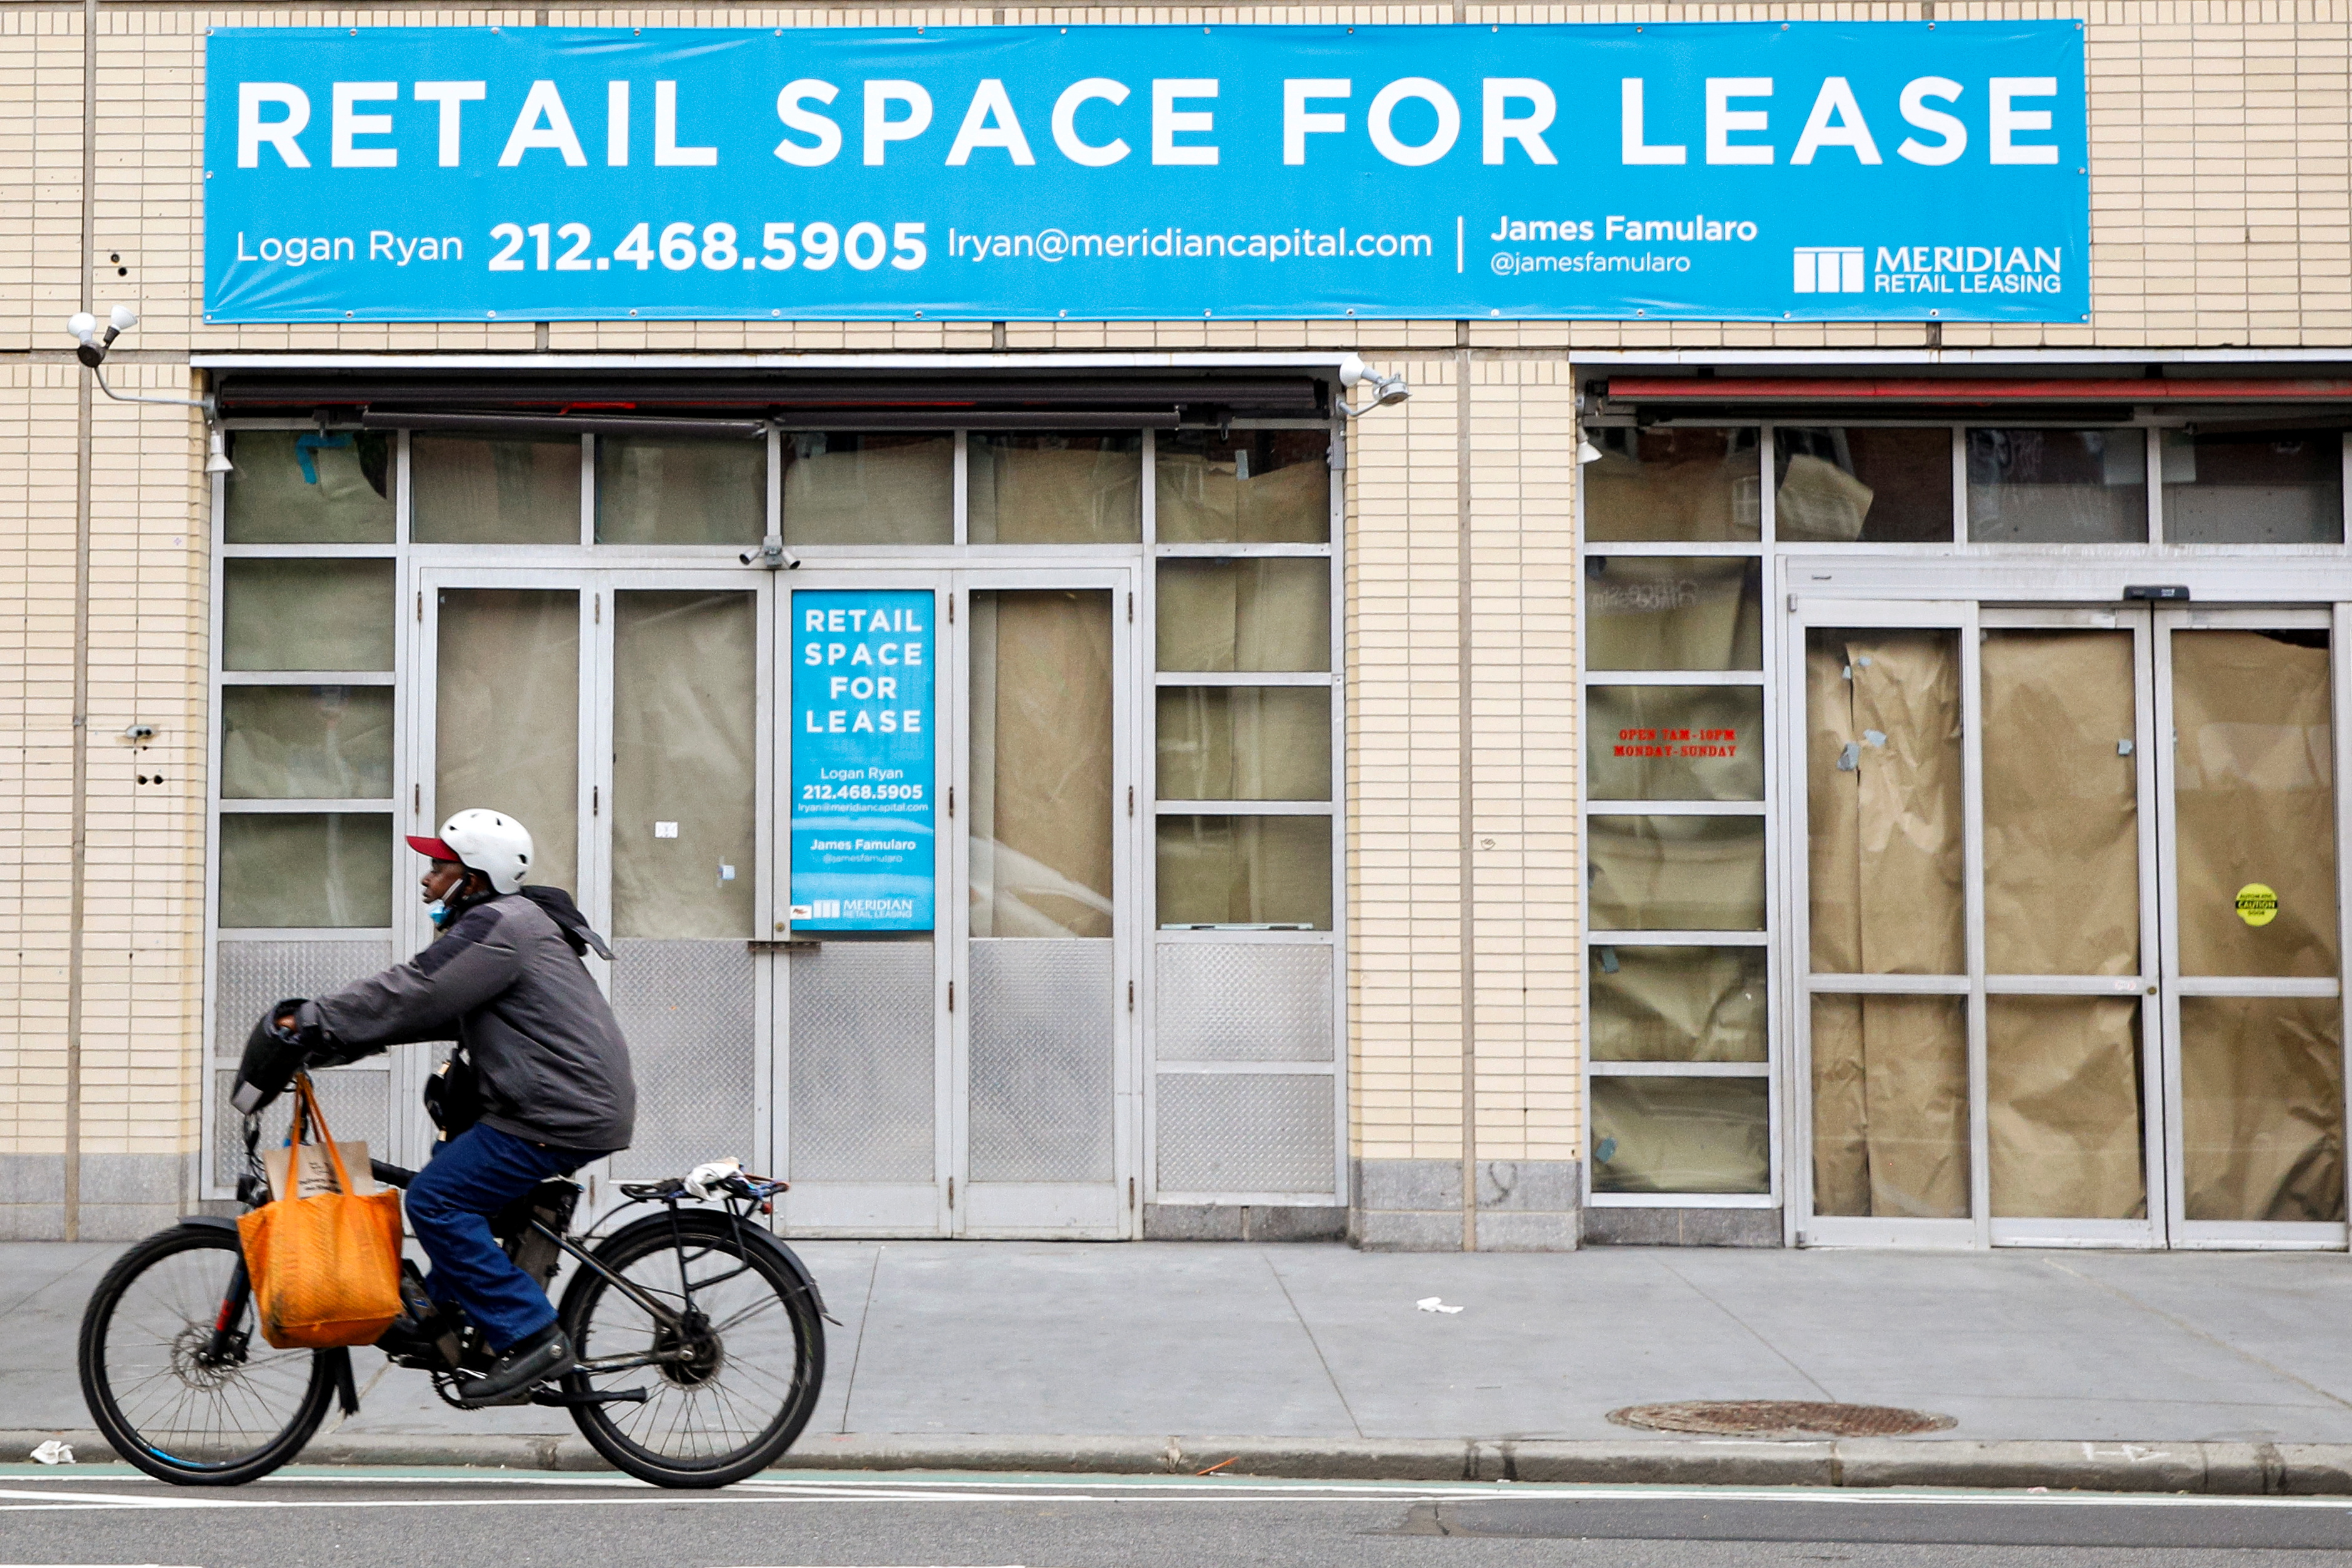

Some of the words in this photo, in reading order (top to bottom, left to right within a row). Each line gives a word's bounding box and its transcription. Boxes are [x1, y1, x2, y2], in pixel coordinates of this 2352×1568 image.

[237, 79, 718, 169] RETAIL
[774, 78, 1220, 168] SPACE
[1283, 76, 1559, 167] FOR
[1622, 76, 2060, 166] LEASE
[1491, 215, 1595, 242] James
[1606, 215, 1758, 242] Famularo
[238, 231, 355, 267] Logan
[370, 230, 463, 267] Ryan
[488, 221, 928, 272] 212.468.5905
[949, 227, 1433, 263] lryan@meridiancapital.com
[1491, 252, 1692, 277] @jamesfamularo
[1874, 246, 2062, 273] MERIDIAN
[1874, 274, 1955, 293] RETAIL
[1960, 273, 2062, 294] LEASING
[805, 609, 923, 633] RETAIL
[805, 643, 923, 666] SPACE
[831, 676, 897, 700] FOR
[806, 710, 922, 734] LEASE
[1618, 728, 1657, 741] OPEN
[1613, 745, 1738, 758] MONDAY-SUNDAY
[821, 768, 864, 780] Logan
[869, 767, 904, 780] Ryan
[803, 784, 924, 801] 212.468.5905
[810, 839, 852, 851] James
[856, 838, 917, 851] Famularo
[844, 899, 913, 910] MERIDIAN
